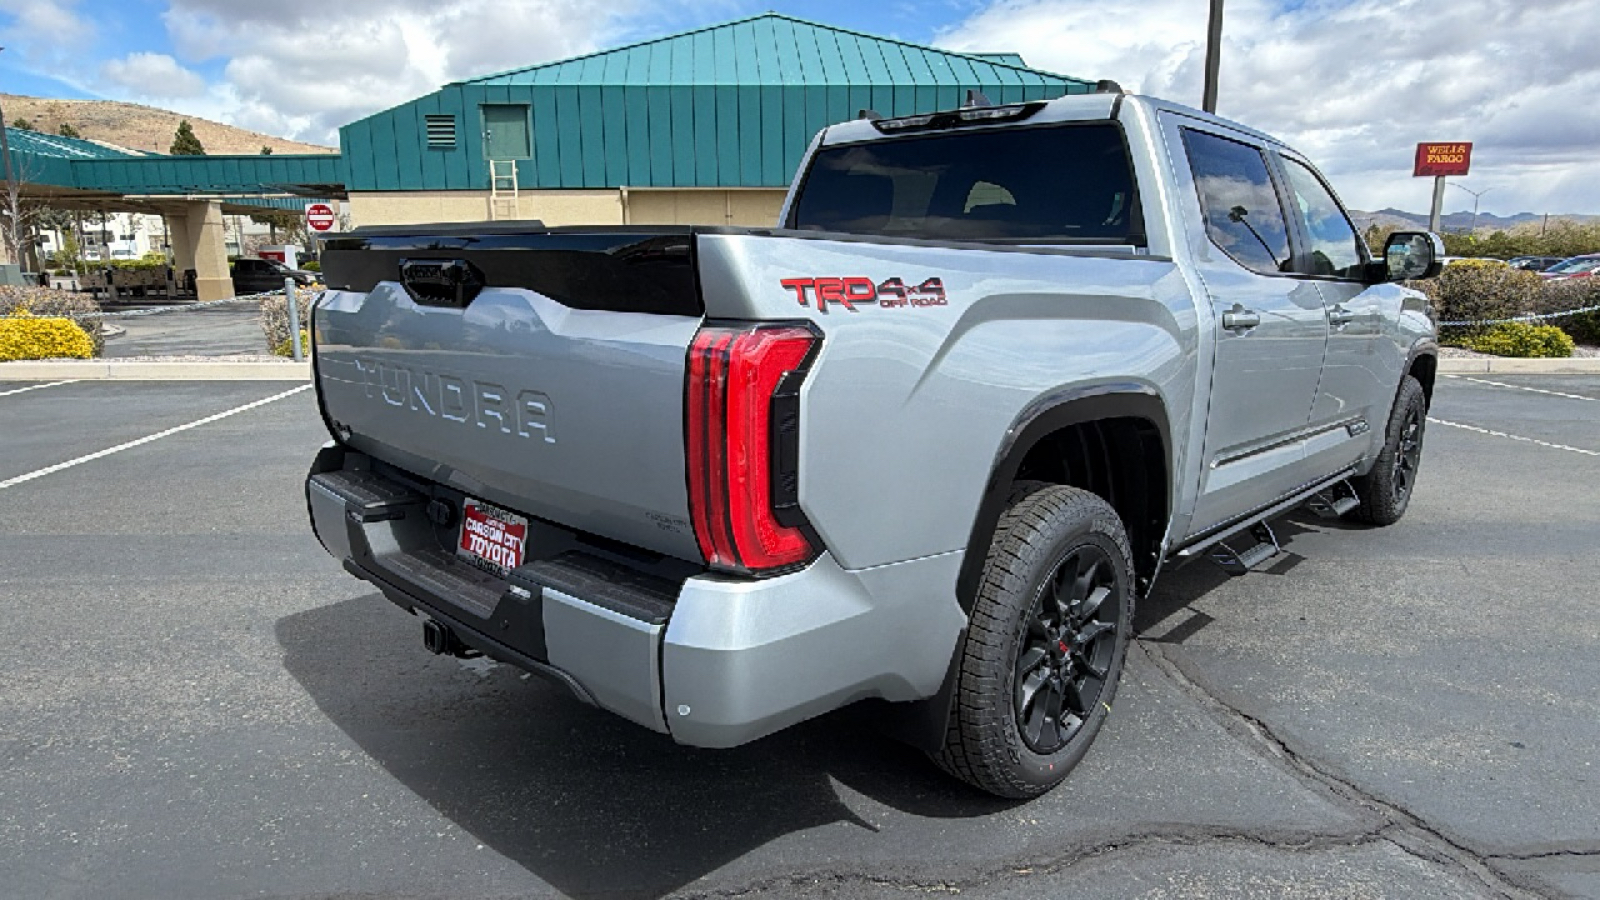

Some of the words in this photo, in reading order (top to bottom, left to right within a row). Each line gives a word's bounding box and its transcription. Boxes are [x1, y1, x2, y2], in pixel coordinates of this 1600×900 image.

[1426, 155, 1464, 163] FARGO
[1427, 145, 1466, 154] WELLS
[780, 277, 878, 314] TRD
[880, 299, 908, 308] OFF
[910, 298, 948, 308] ROAD
[355, 359, 556, 443] TUNDRA
[465, 517, 503, 543] CARSON
[504, 532, 524, 554] CITY
[469, 534, 516, 569] TOYOTA
